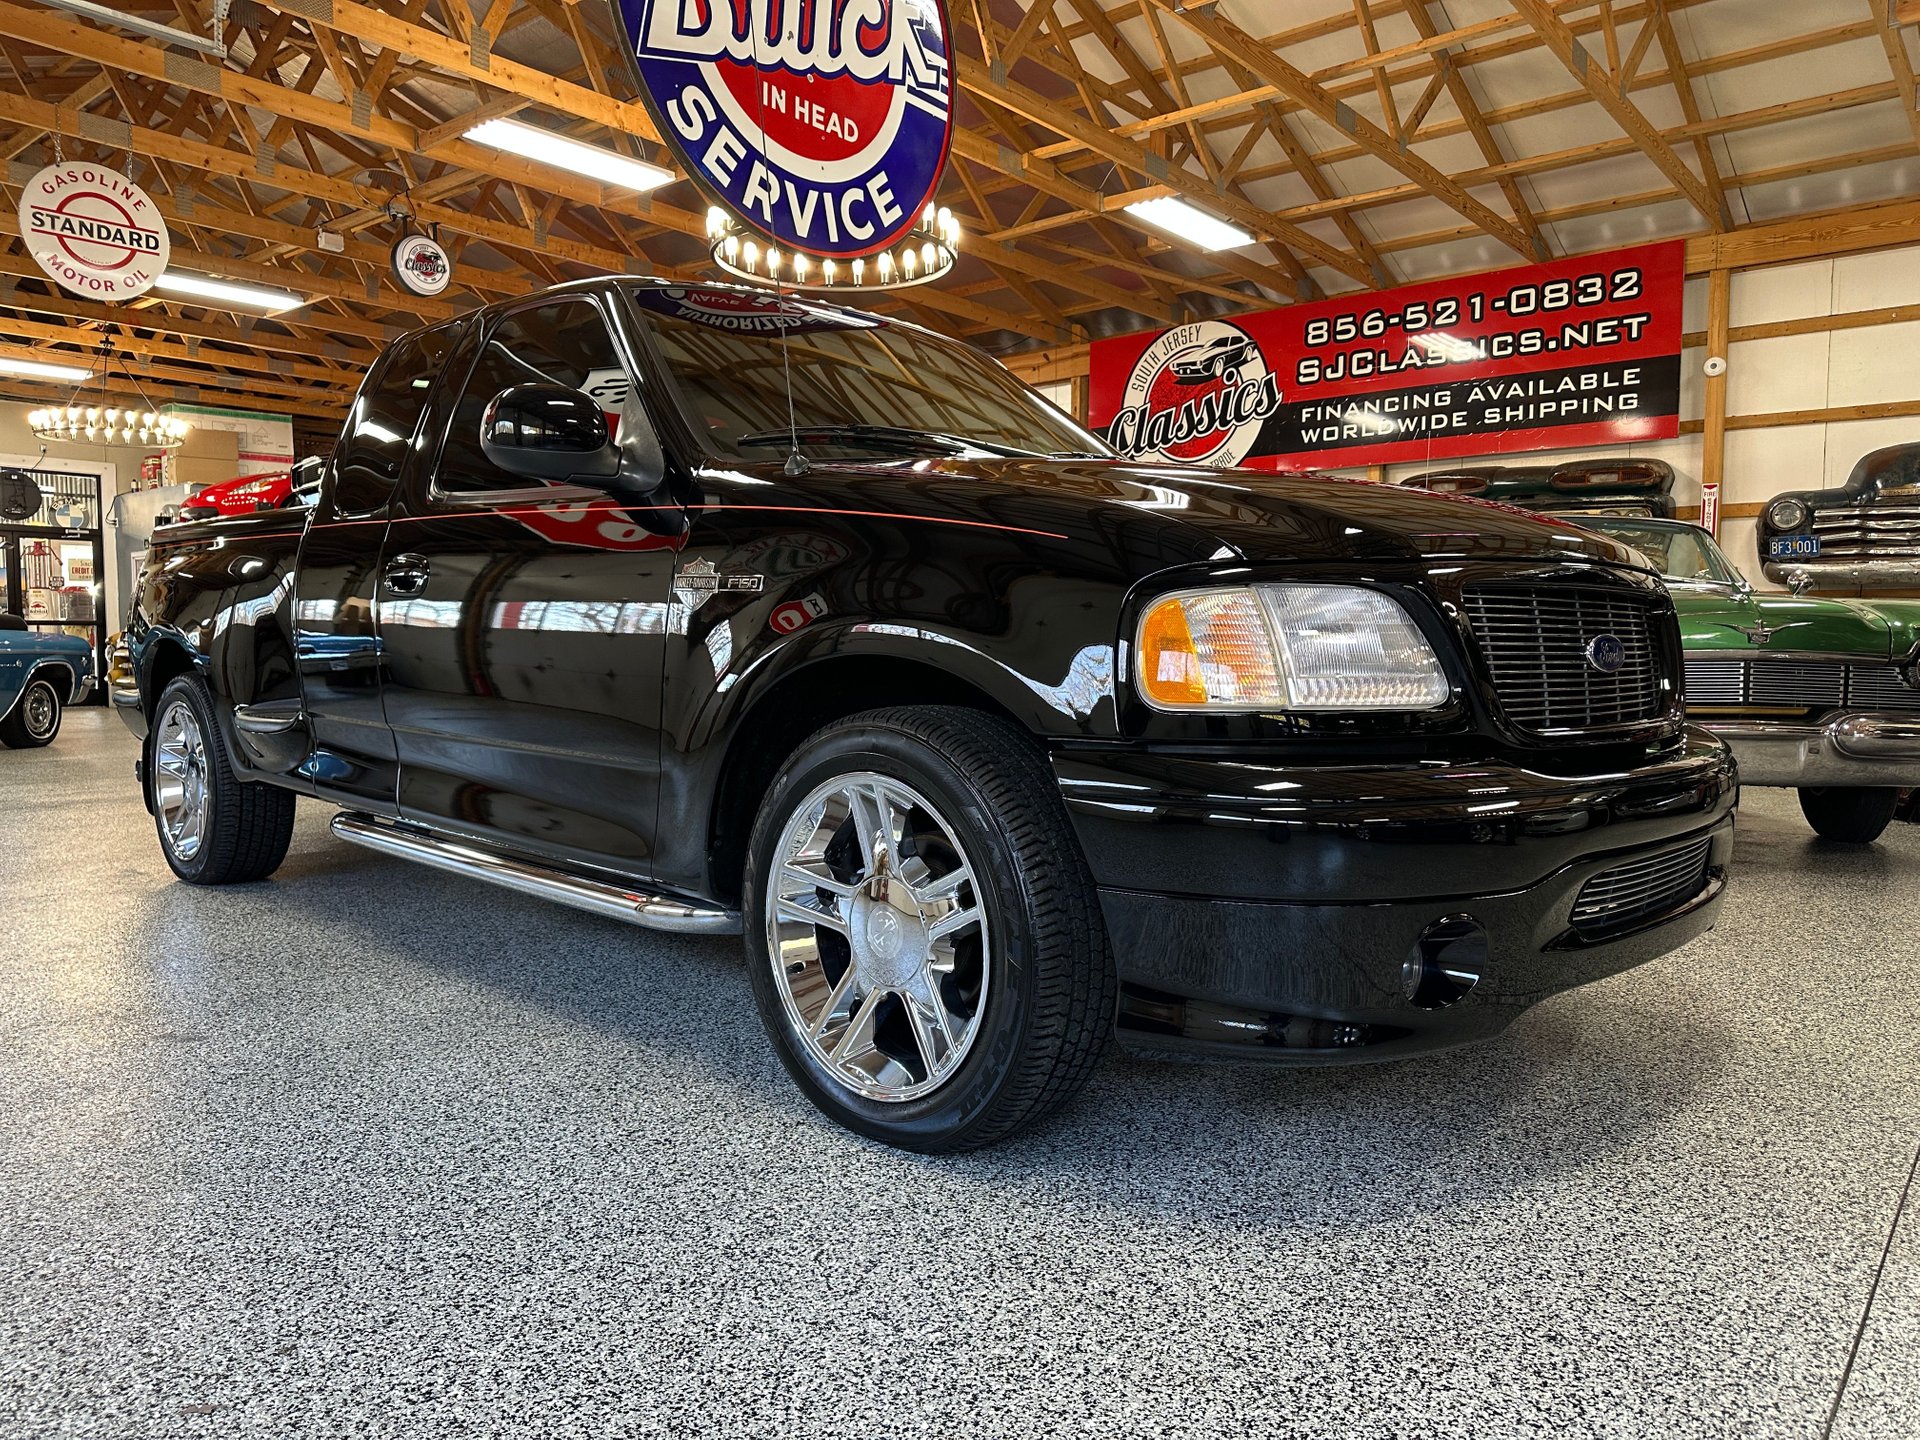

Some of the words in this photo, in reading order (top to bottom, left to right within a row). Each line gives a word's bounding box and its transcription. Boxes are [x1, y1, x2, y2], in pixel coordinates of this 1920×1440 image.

[763, 81, 786, 114] IN
[795, 96, 859, 143] HEAD
[42, 170, 146, 211] GASOLINE
[667, 85, 902, 243] SERVICE
[31, 211, 159, 250] STANDARD
[47, 254, 116, 291] MOTOR
[123, 270, 149, 287] OIL
[1306, 271, 1639, 345] 856-521-0832
[1131, 352, 1161, 392] SOUTH
[1162, 325, 1202, 355] JERSEY
[1109, 367, 1282, 456] Classics
[1301, 411, 1468, 443] WORLDWIDE
[1484, 393, 1639, 424] SHIPPING
[1302, 390, 1452, 422] FINANCING
[1467, 368, 1641, 403] AVAILABLE
[1771, 541, 1792, 555] BF3
[1797, 539, 1818, 553] 001
